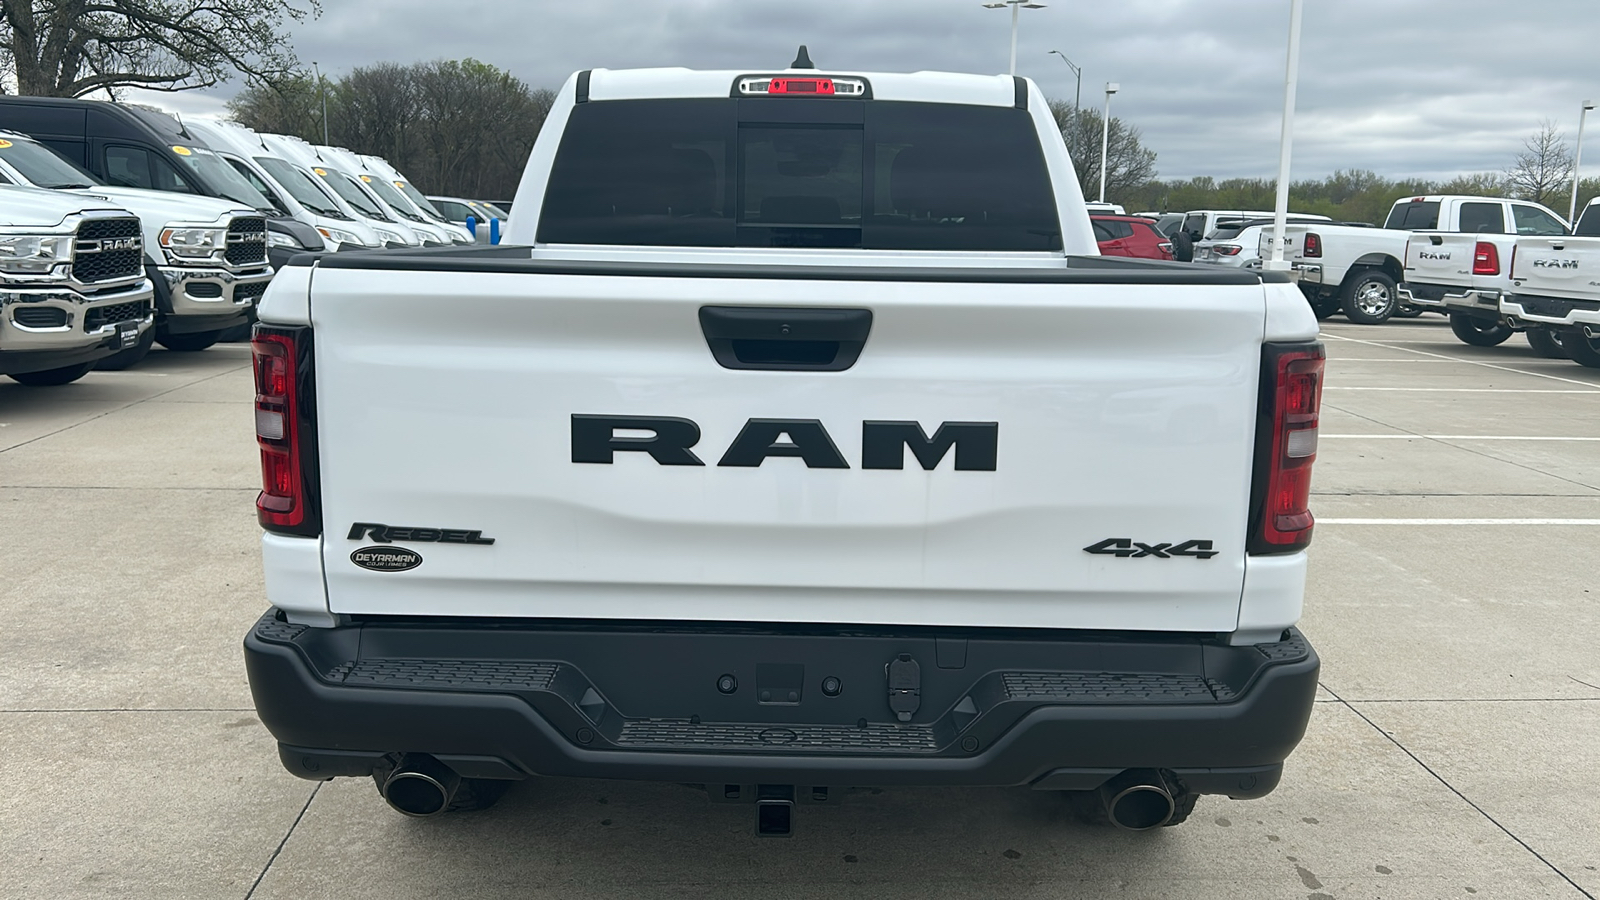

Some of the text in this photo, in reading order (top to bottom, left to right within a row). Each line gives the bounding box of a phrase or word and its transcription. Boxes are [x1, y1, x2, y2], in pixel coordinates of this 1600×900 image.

[103, 239, 133, 250] RAM
[1268, 236, 1292, 245] RM
[1419, 251, 1451, 260] RAM
[1533, 259, 1580, 269] RAM
[570, 413, 999, 471] RAM
[346, 522, 496, 545] REBEL
[1082, 538, 1220, 559] 4x4
[355, 553, 416, 563] DEYARMAN
